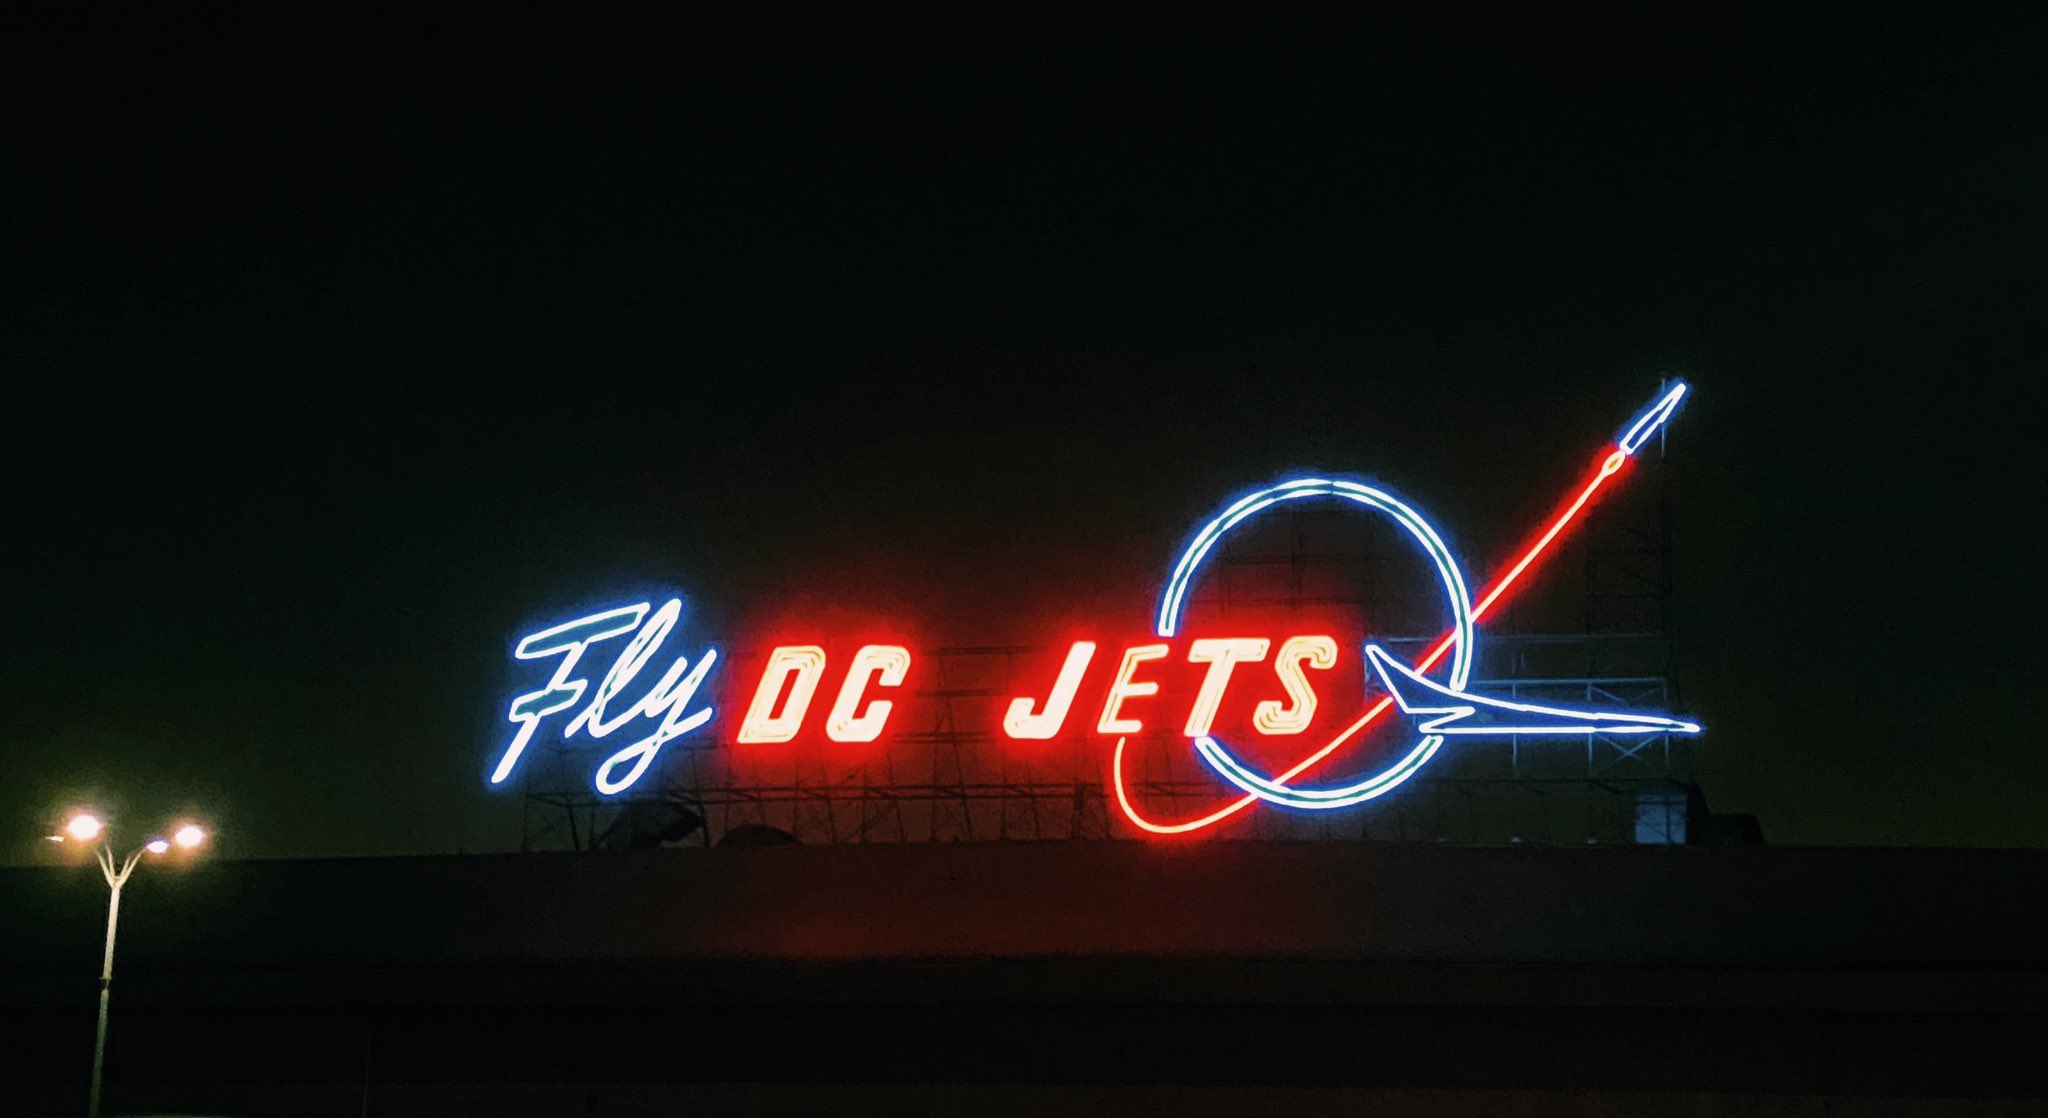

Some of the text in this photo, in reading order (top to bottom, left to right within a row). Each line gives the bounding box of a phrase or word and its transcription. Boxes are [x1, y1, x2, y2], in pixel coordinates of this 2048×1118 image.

[490, 597, 1339, 796] Fly DC JETS
